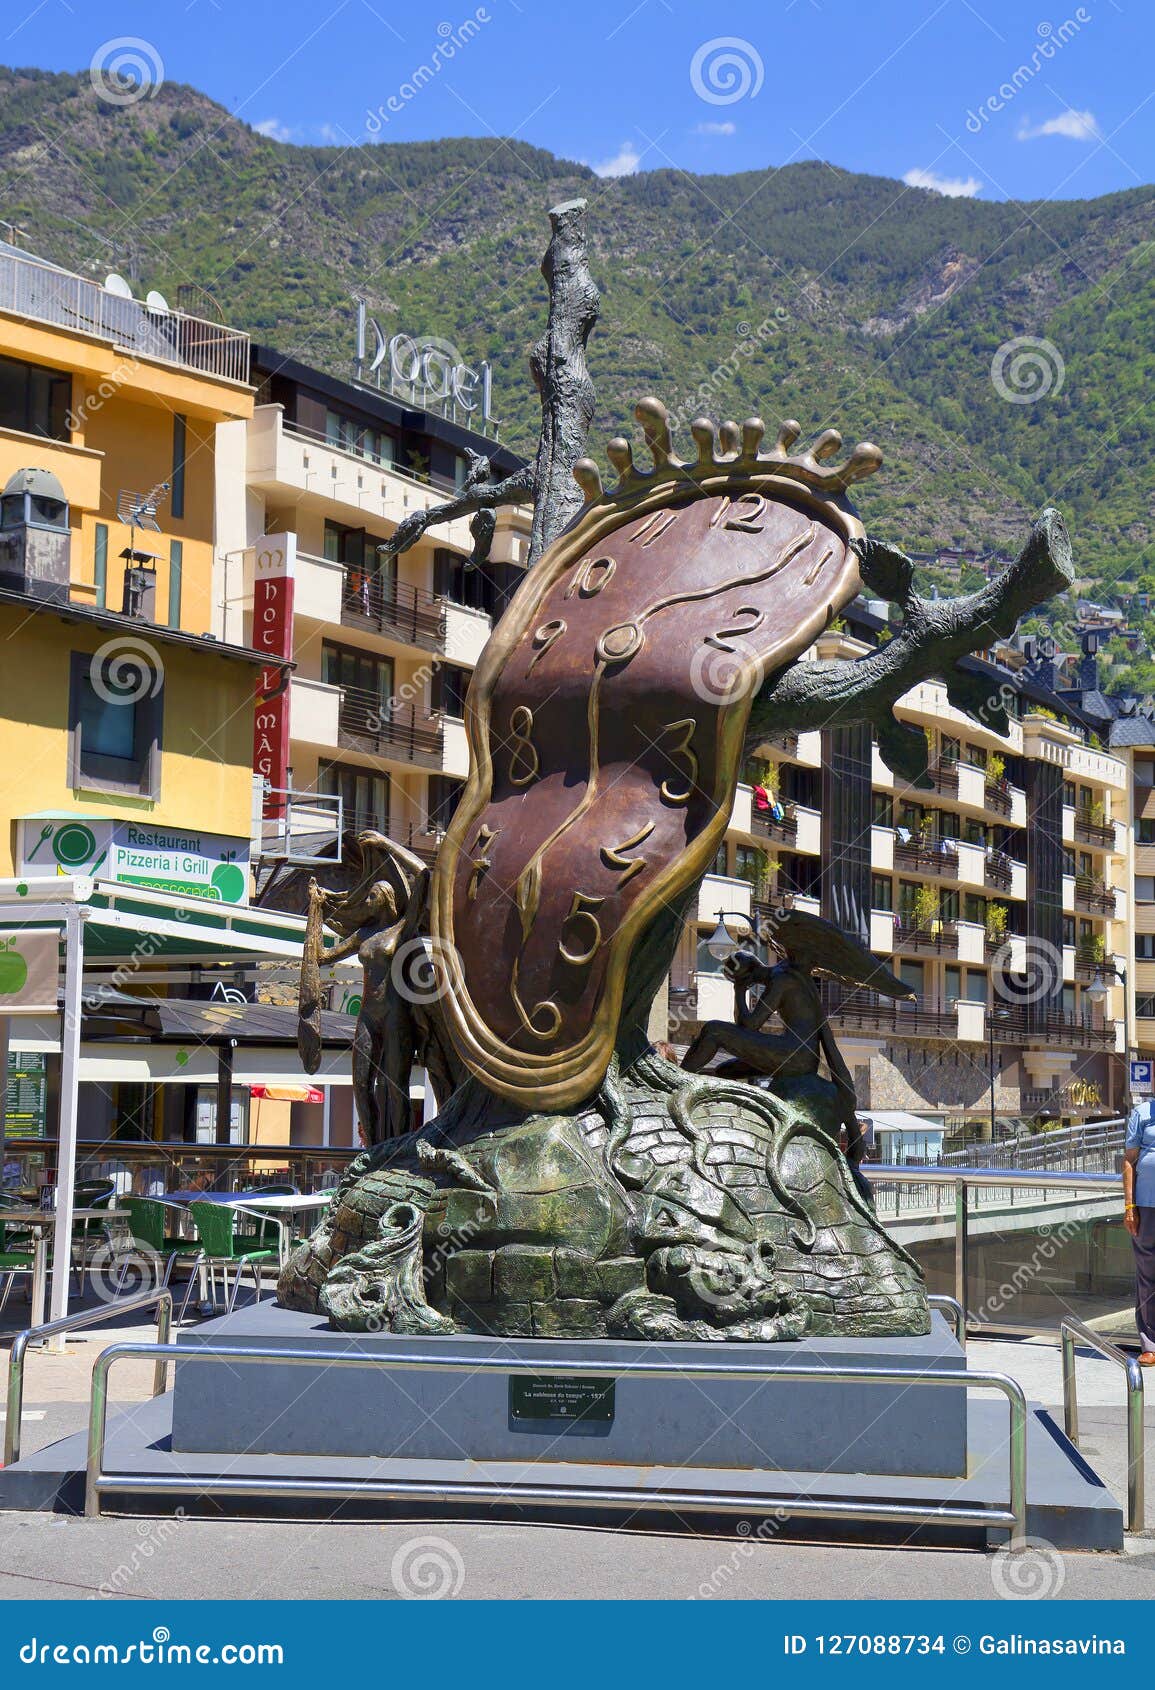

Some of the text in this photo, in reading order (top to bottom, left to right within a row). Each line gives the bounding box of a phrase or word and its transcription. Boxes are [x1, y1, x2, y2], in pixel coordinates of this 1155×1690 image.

[628, 511, 678, 548] 11
[710, 493, 765, 534] 12
[564, 556, 616, 600] 10
[525, 619, 567, 679] 9
[704, 607, 765, 653] 2
[509, 705, 539, 785] 8
[660, 719, 698, 800] 3
[128, 828, 201, 852] Restaurant
[117, 850, 170, 870] Pizzeria
[183, 858, 208, 875] Grill
[559, 891, 605, 965] 5
[1134, 1065, 1148, 1080] P
